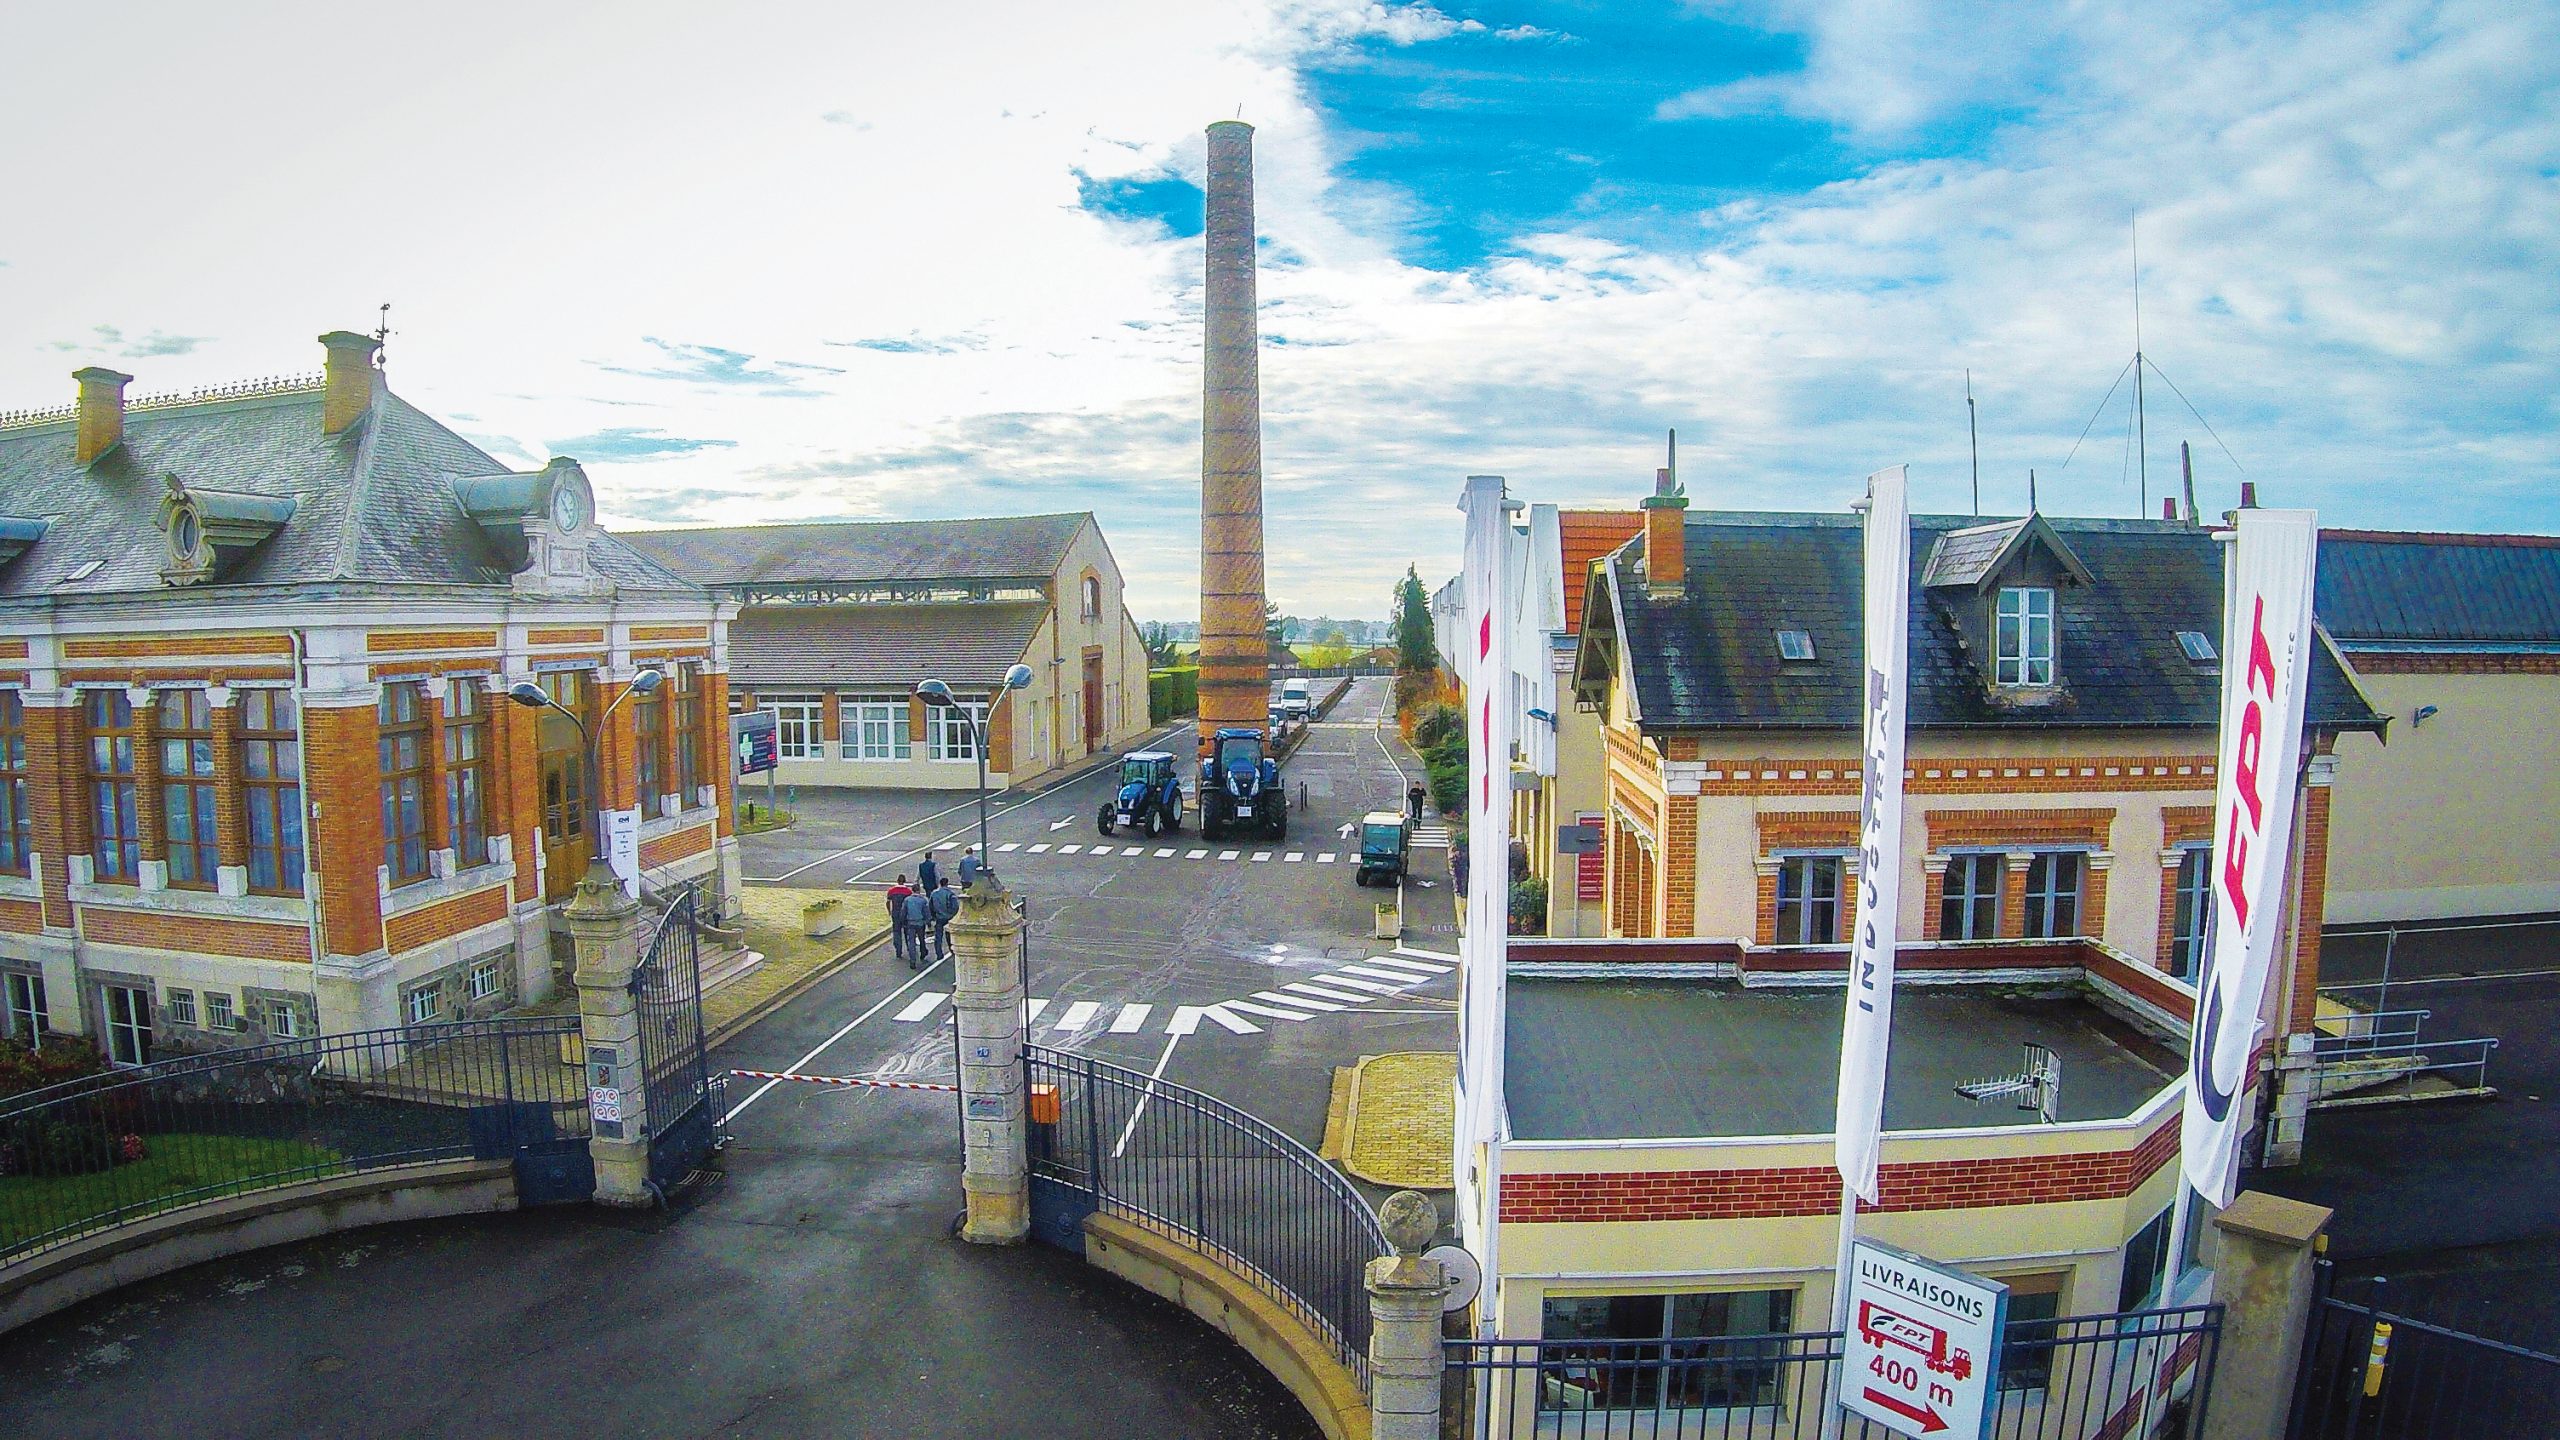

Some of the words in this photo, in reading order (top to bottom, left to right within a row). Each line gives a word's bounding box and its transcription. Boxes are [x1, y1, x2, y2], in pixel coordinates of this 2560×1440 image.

[2223, 590, 2276, 939] FPT
[1861, 1259, 1984, 1319] LIVRAISONS
[1891, 1323, 1931, 1343] FPT
[1869, 1354, 1918, 1391] 400
[1928, 1381, 1954, 1408] m
